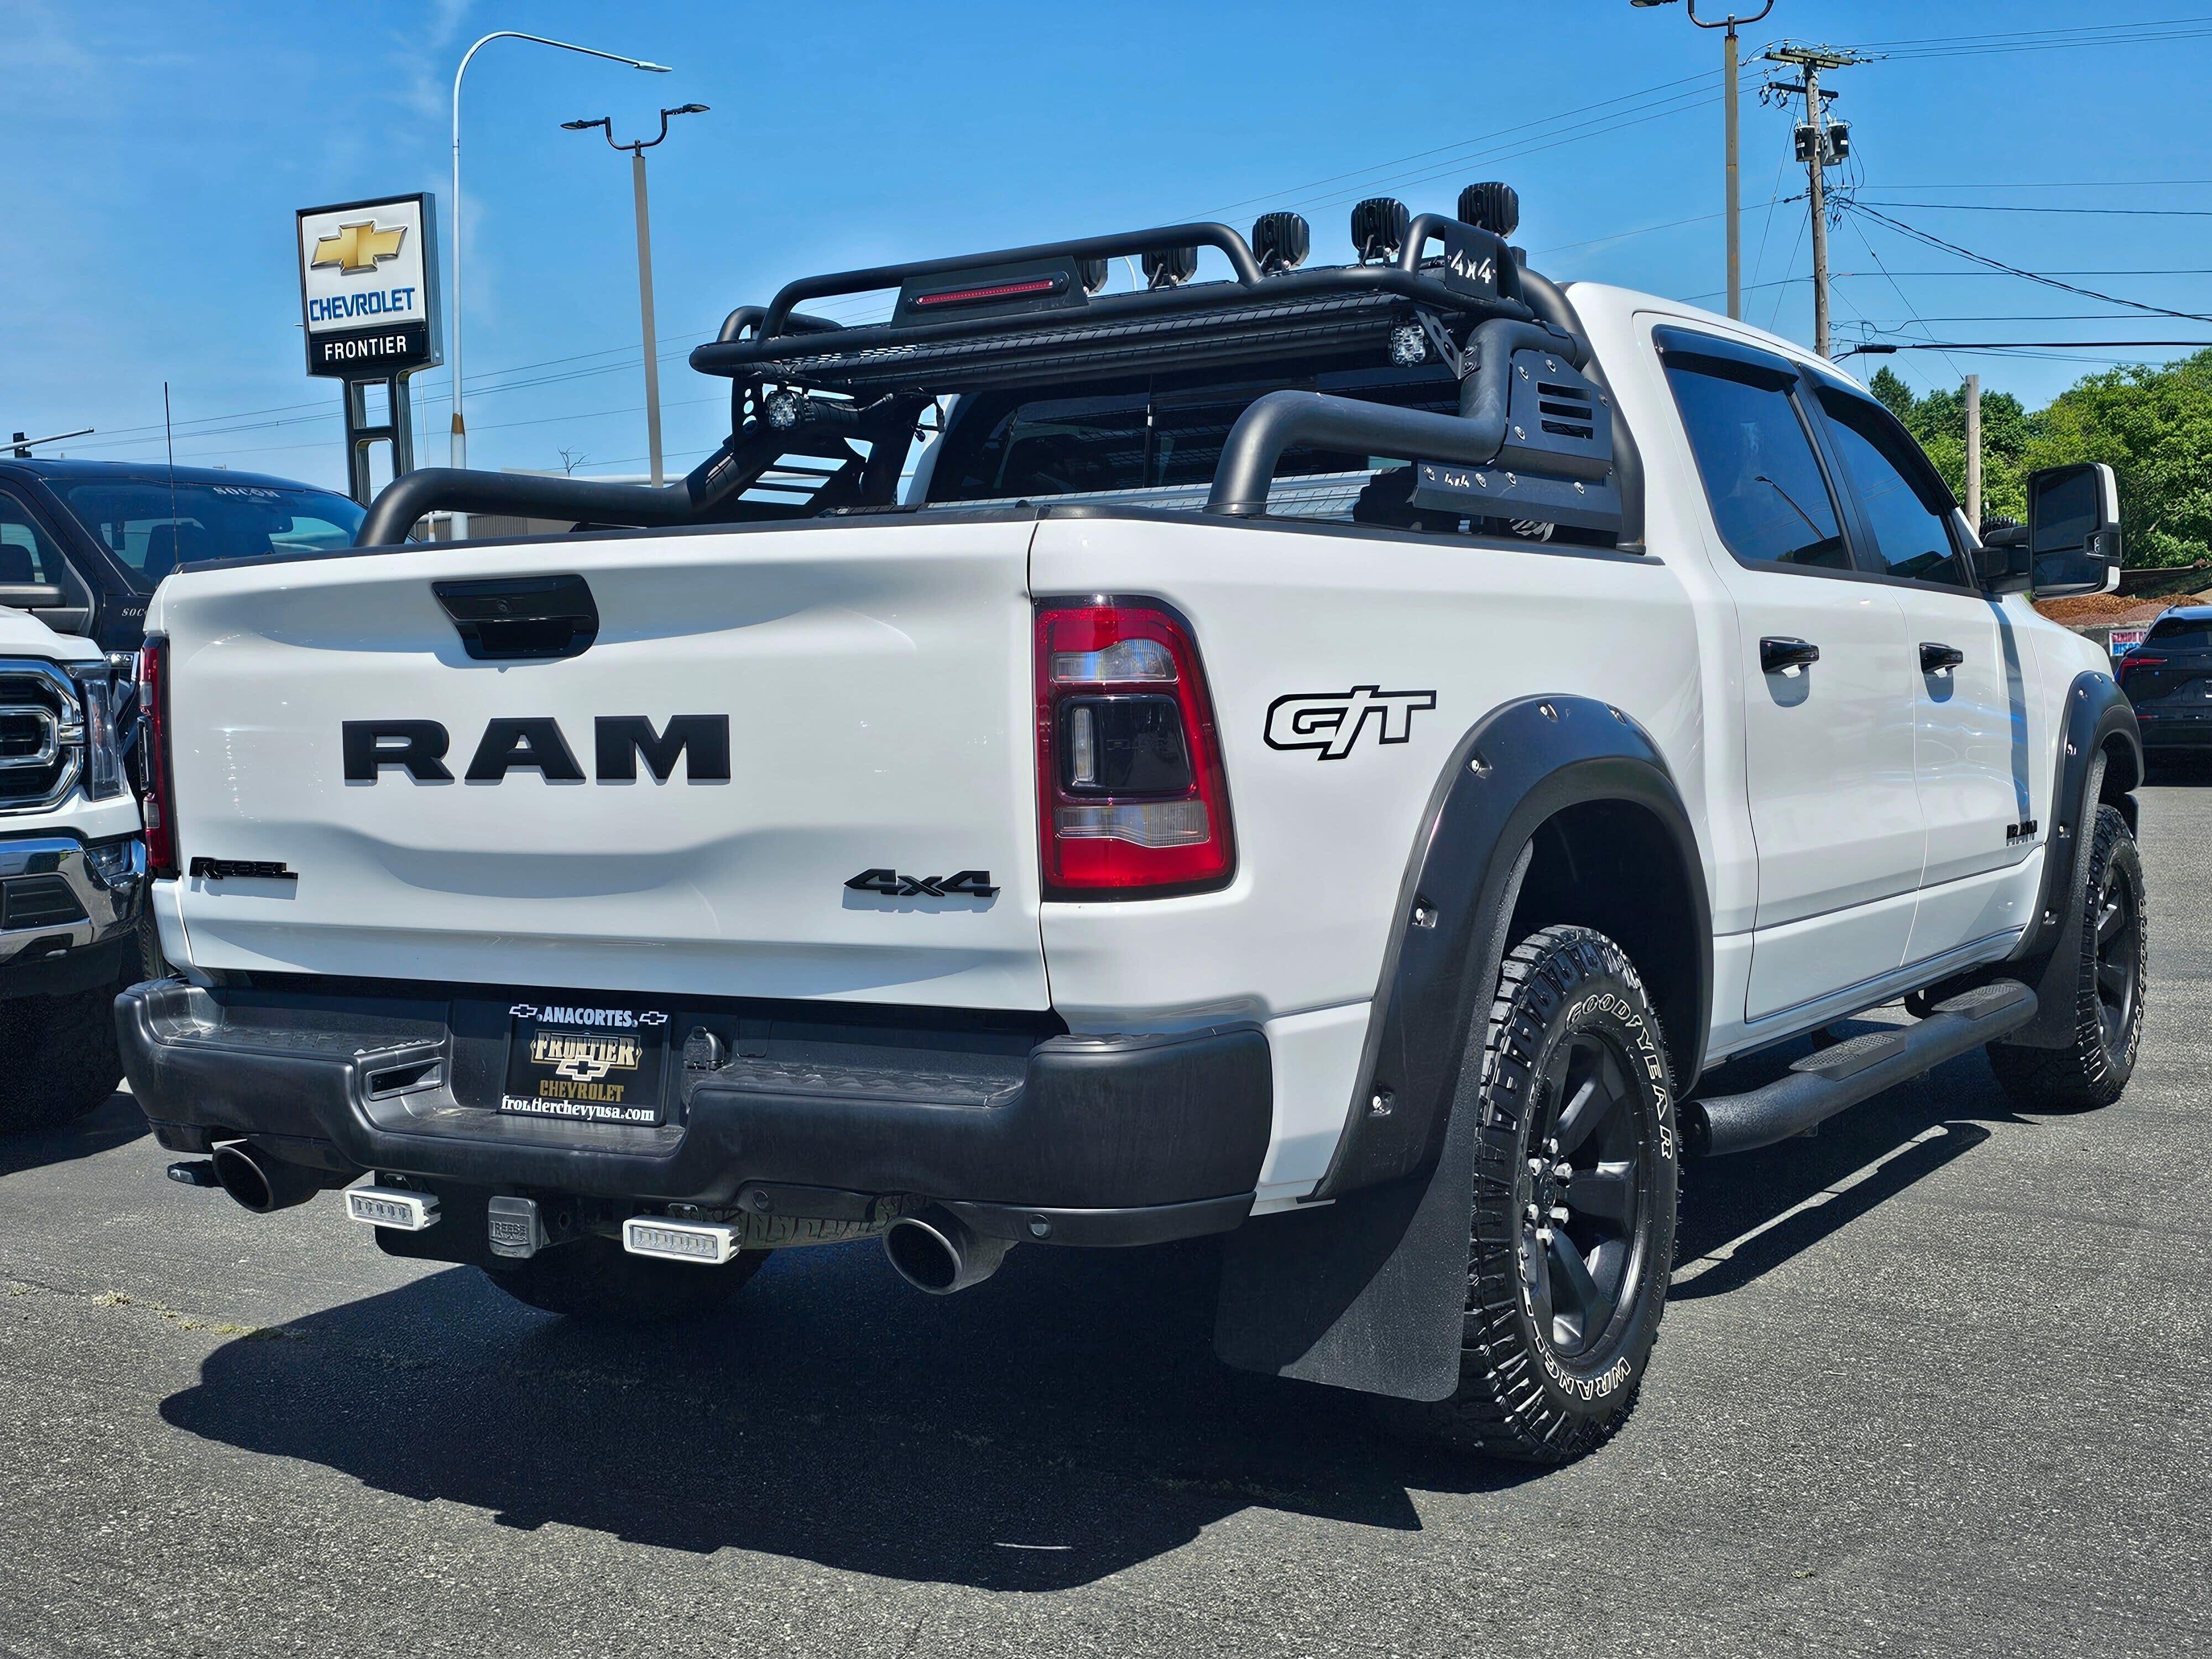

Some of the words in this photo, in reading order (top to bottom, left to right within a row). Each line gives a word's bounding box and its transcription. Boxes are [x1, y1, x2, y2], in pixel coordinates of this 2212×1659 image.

[309, 287, 415, 321] CHEVROLET
[325, 335, 407, 360] FRONTIER
[121, 608, 148, 617] SOC
[342, 714, 731, 780] RAM
[2006, 820, 2038, 840] RAM
[542, 1006, 632, 1027] ANACORTES
[534, 1032, 635, 1066] FRONTIER
[1566, 993, 1673, 1159] GOODYEAR
[539, 1080, 624, 1102] CHEVROLET
